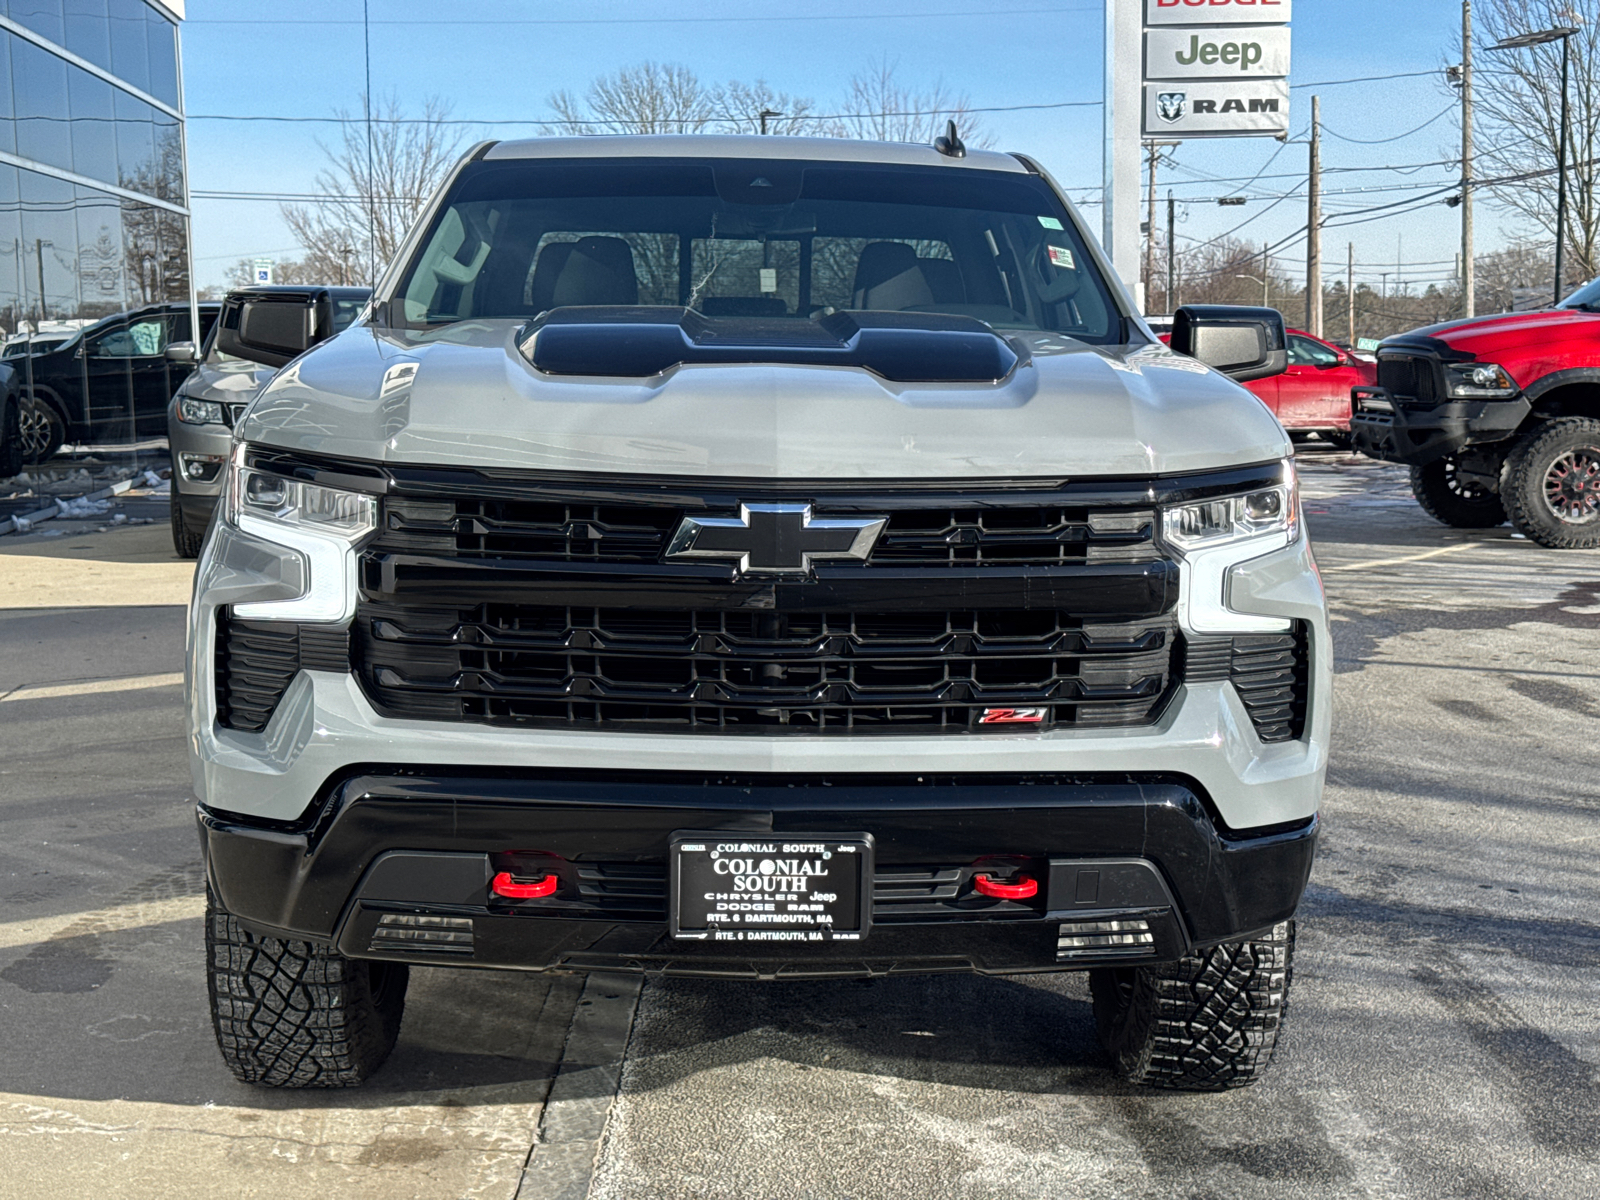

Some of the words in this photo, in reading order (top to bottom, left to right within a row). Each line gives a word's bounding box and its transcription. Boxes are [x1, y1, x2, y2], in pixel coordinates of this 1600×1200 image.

[1175, 35, 1262, 71] Jeep
[1193, 99, 1279, 114] RAM
[783, 844, 825, 853] SOUTH
[838, 845, 856, 853] Jeep
[713, 859, 828, 876] COLONIAL
[734, 876, 808, 892] SOUTH
[810, 892, 837, 902] Jeep
[717, 903, 775, 911] DODGE
[707, 914, 730, 922] RTE.
[733, 914, 740, 922] 6
[745, 915, 815, 924] DARTMOUTH,
[817, 915, 833, 923] MA
[715, 932, 736, 940] RTE.
[738, 932, 744, 940] 6
[747, 932, 807, 941] DARTMOUTH,
[809, 932, 823, 940] MA
